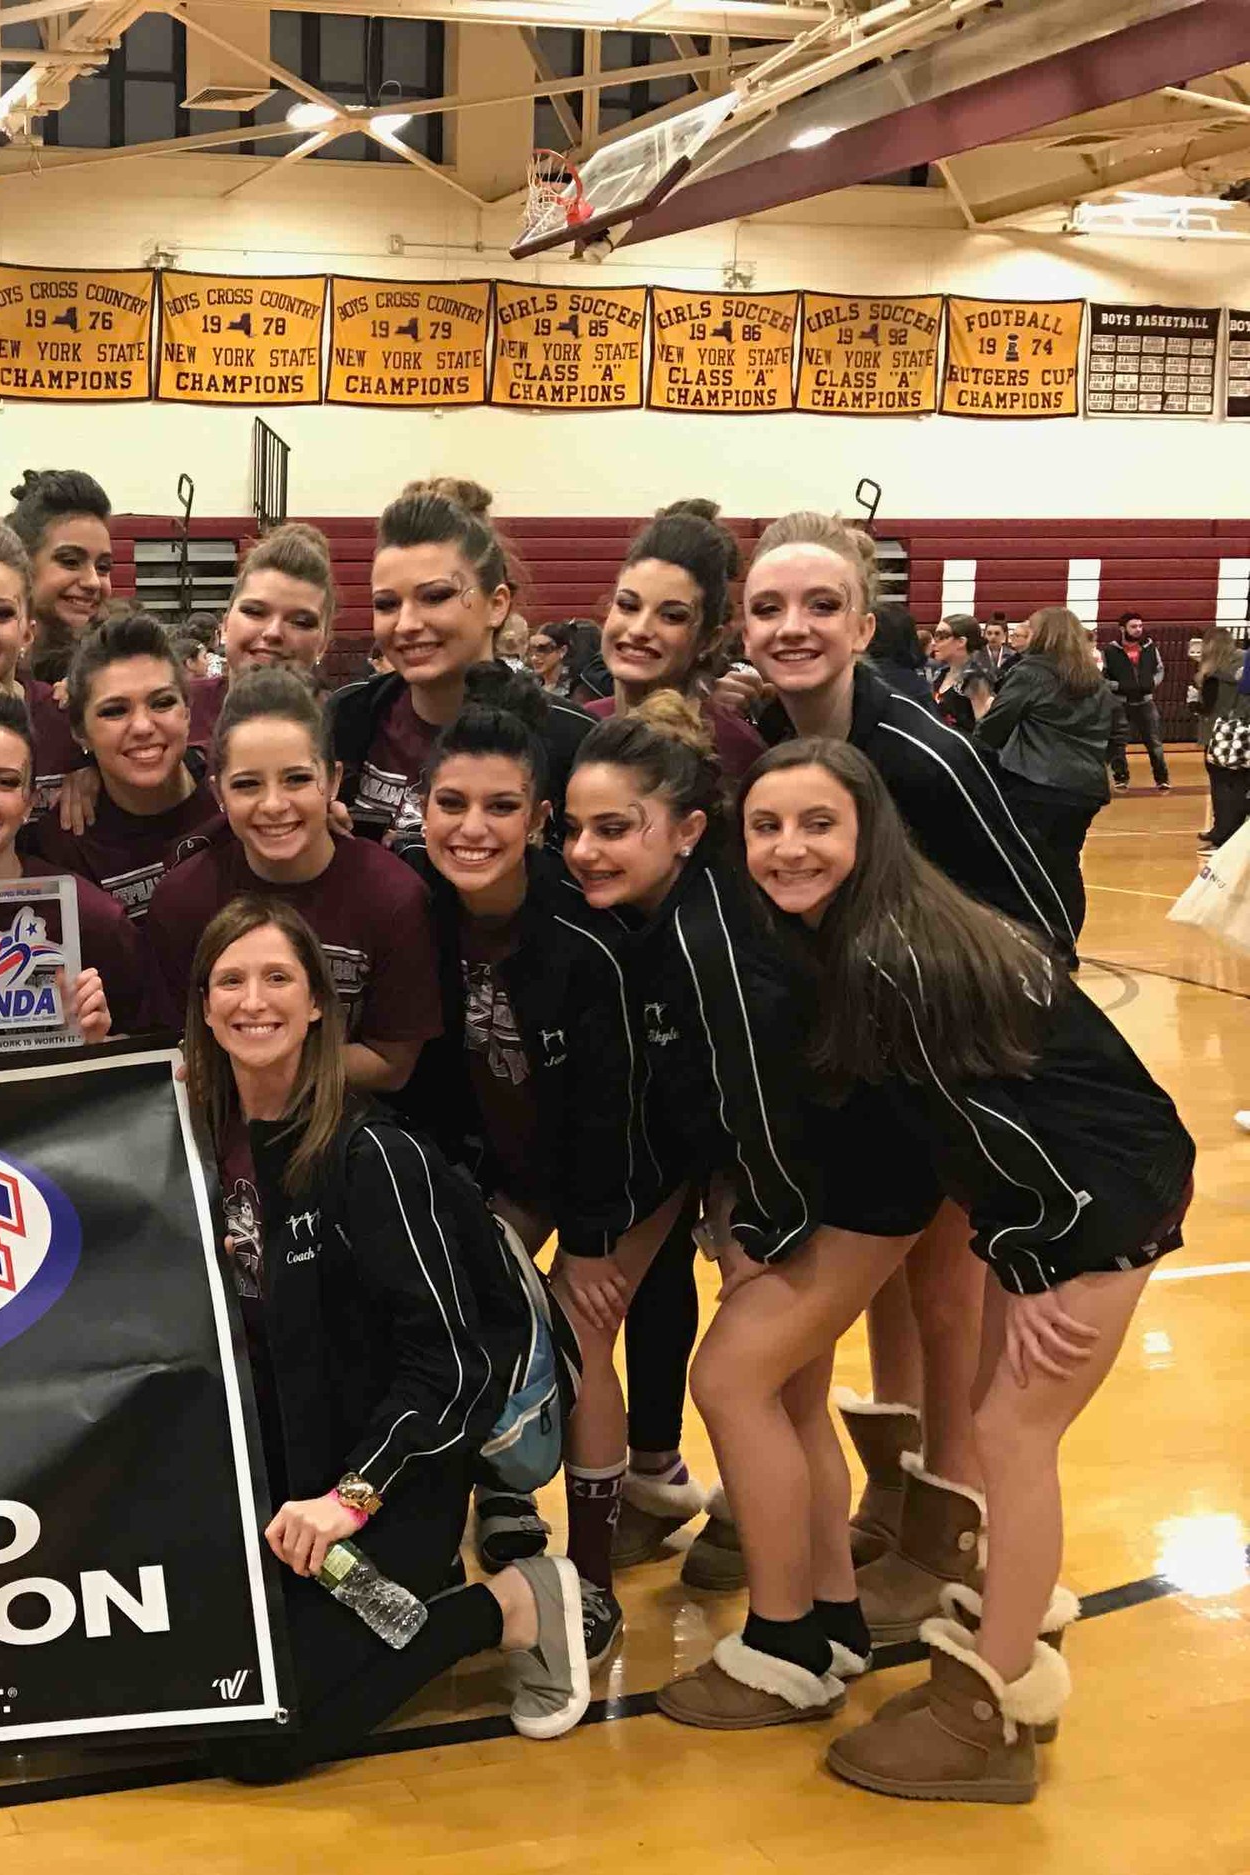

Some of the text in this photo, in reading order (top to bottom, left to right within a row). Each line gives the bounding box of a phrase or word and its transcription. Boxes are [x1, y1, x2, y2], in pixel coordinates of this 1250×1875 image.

[30, 281, 78, 299] CROSS
[86, 284, 148, 315] COUNTRY
[165, 288, 321, 321] BOYS CROSS COUNTRY
[337, 292, 484, 325] BOYS CROSS COUNTRY
[499, 294, 642, 330] GIRLS SOCCER
[656, 300, 793, 333] GIRLS SOCCER
[25, 308, 113, 330] 19 76
[201, 315, 286, 335] 19 78
[533, 319, 609, 337] 19 85
[807, 303, 936, 335] GIRLS SOCCER
[965, 310, 1063, 336] FOOTBALL
[1101, 313, 1209, 329] BOYS BASKETBALL
[370, 320, 452, 340] 19 79
[689, 323, 761, 342] 19 86
[837, 328, 908, 345] 19 92
[37, 342, 82, 362] YORK
[97, 342, 145, 362] STATE
[165, 343, 317, 367] NEW YORK STATE
[542, 341, 639, 361] YORK STATE
[699, 347, 791, 366] YORK STATE
[979, 337, 1053, 356] 19 74
[335, 348, 483, 370] NEW YORK STATE
[845, 349, 934, 368] YORK STATE
[0, 367, 133, 390] CHAMPIONS
[513, 363, 579, 381] CLASS
[668, 367, 733, 386] CLASS
[815, 370, 876, 388] CLASS
[950, 364, 1075, 386] RUTGERS CUP
[176, 372, 304, 393] CHAMPIONS
[345, 375, 470, 395] CHAMPIONS
[509, 383, 626, 402] CHAMPIONS
[666, 388, 777, 407] CHAMPIONS
[812, 390, 921, 408] CHAMPIONS
[957, 390, 1063, 409] CHAMPIONS
